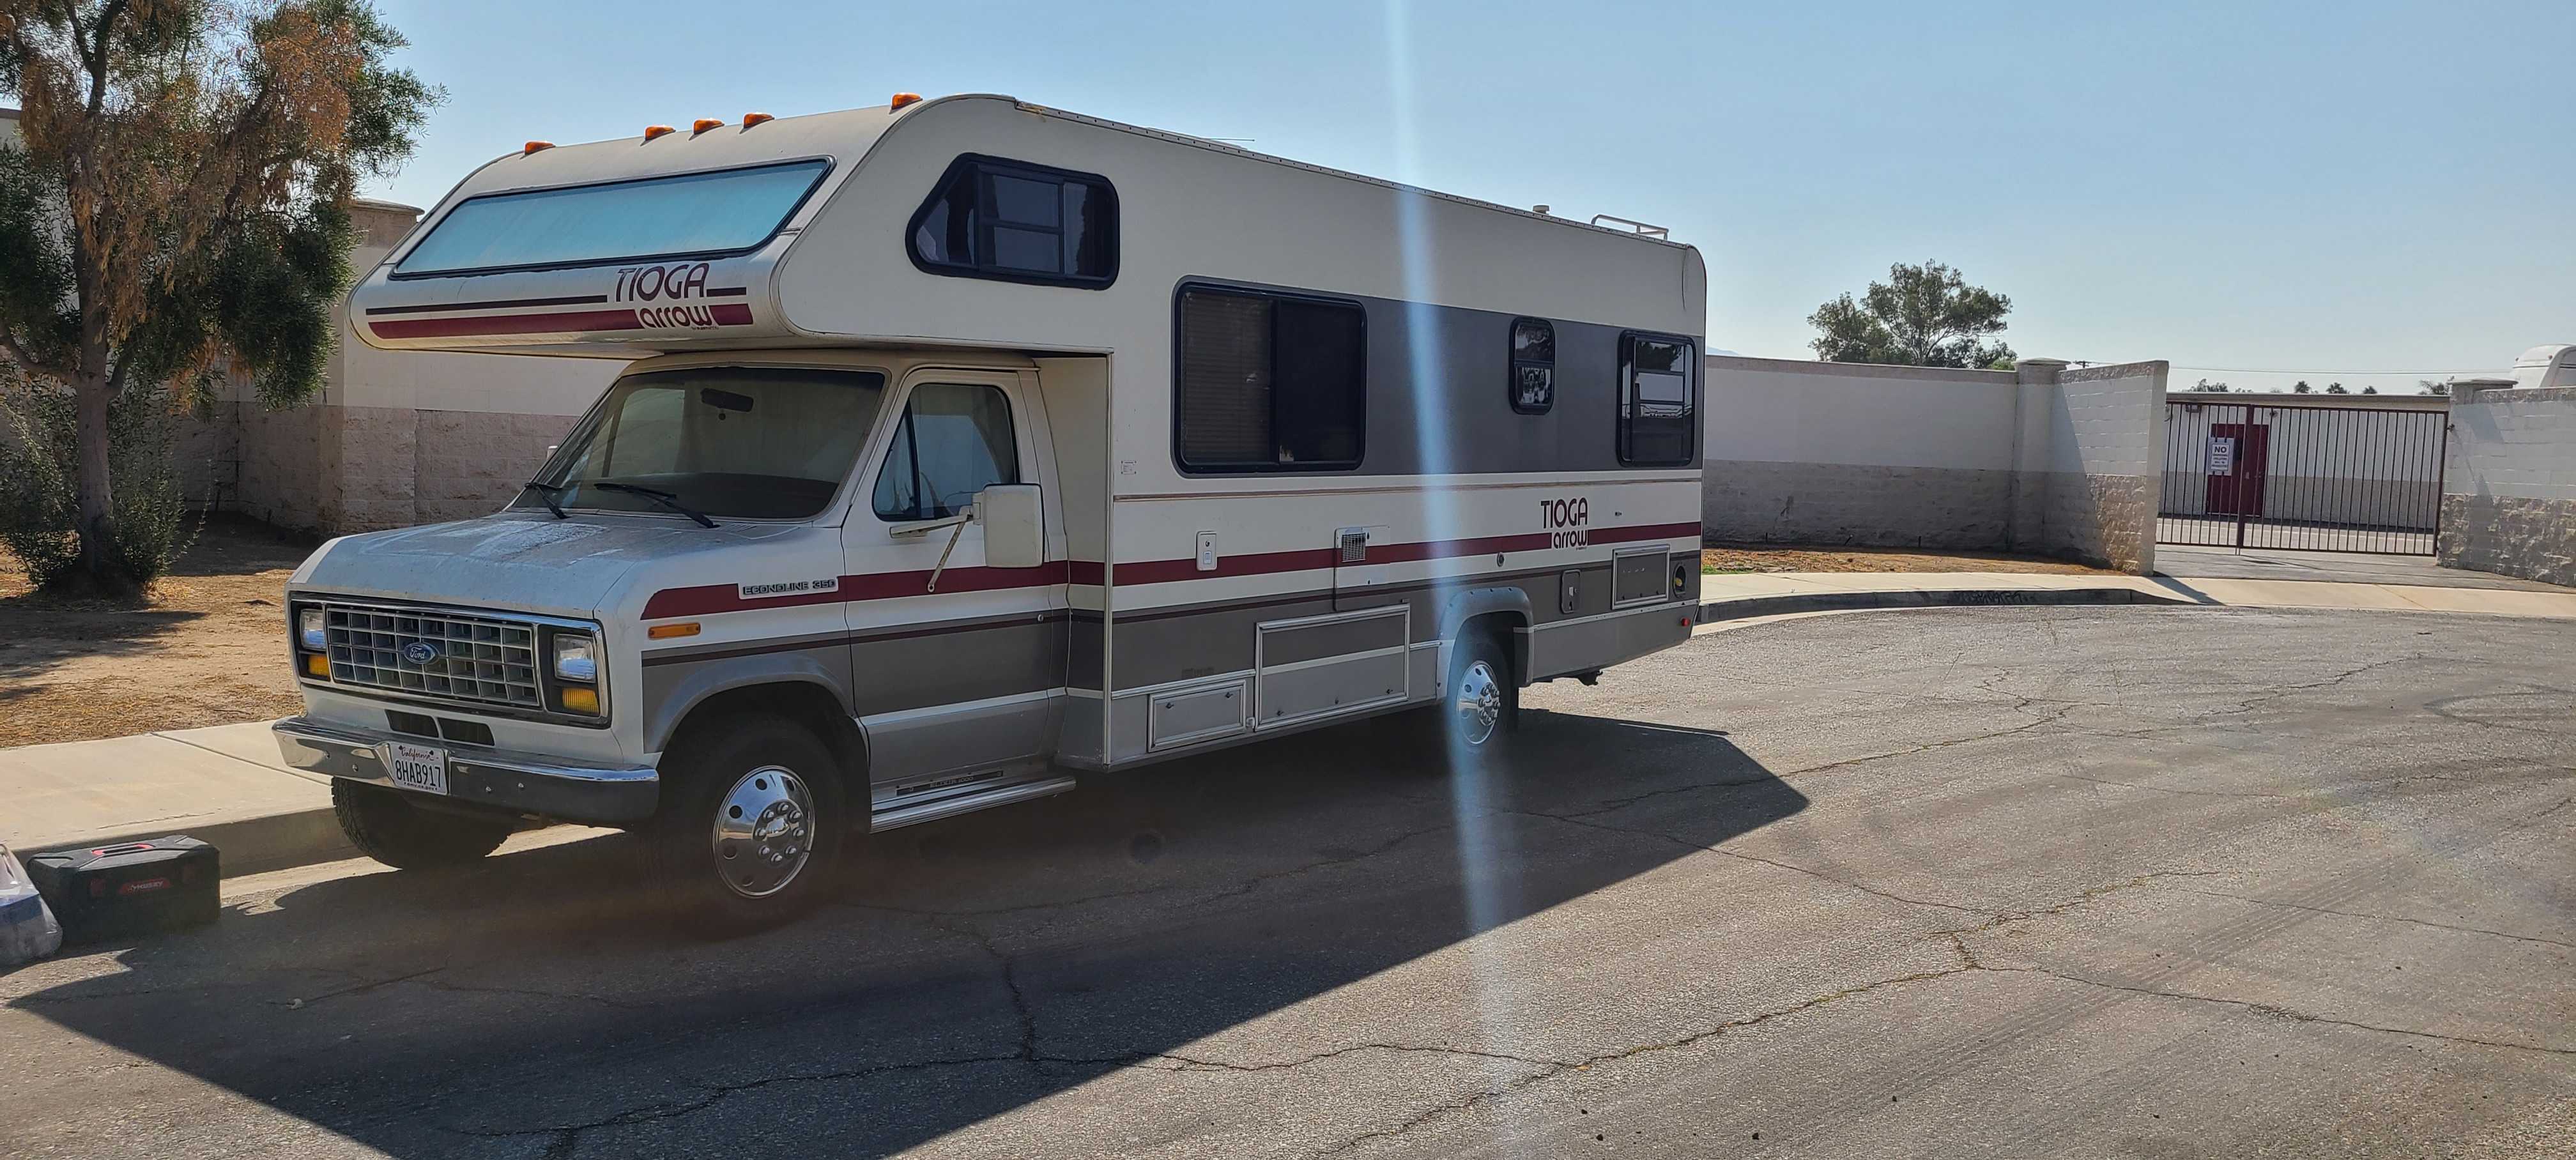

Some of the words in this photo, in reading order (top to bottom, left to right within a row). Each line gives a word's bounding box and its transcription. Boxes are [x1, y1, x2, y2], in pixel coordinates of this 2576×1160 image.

[616, 263, 709, 302] TIOGA
[1540, 497, 1588, 529] TIOGA
[742, 581, 809, 595] ECONOLINE
[812, 579, 836, 589] 350
[410, 646, 425, 659] Ford
[401, 746, 434, 761] California
[395, 759, 441, 788] 8HAB917
